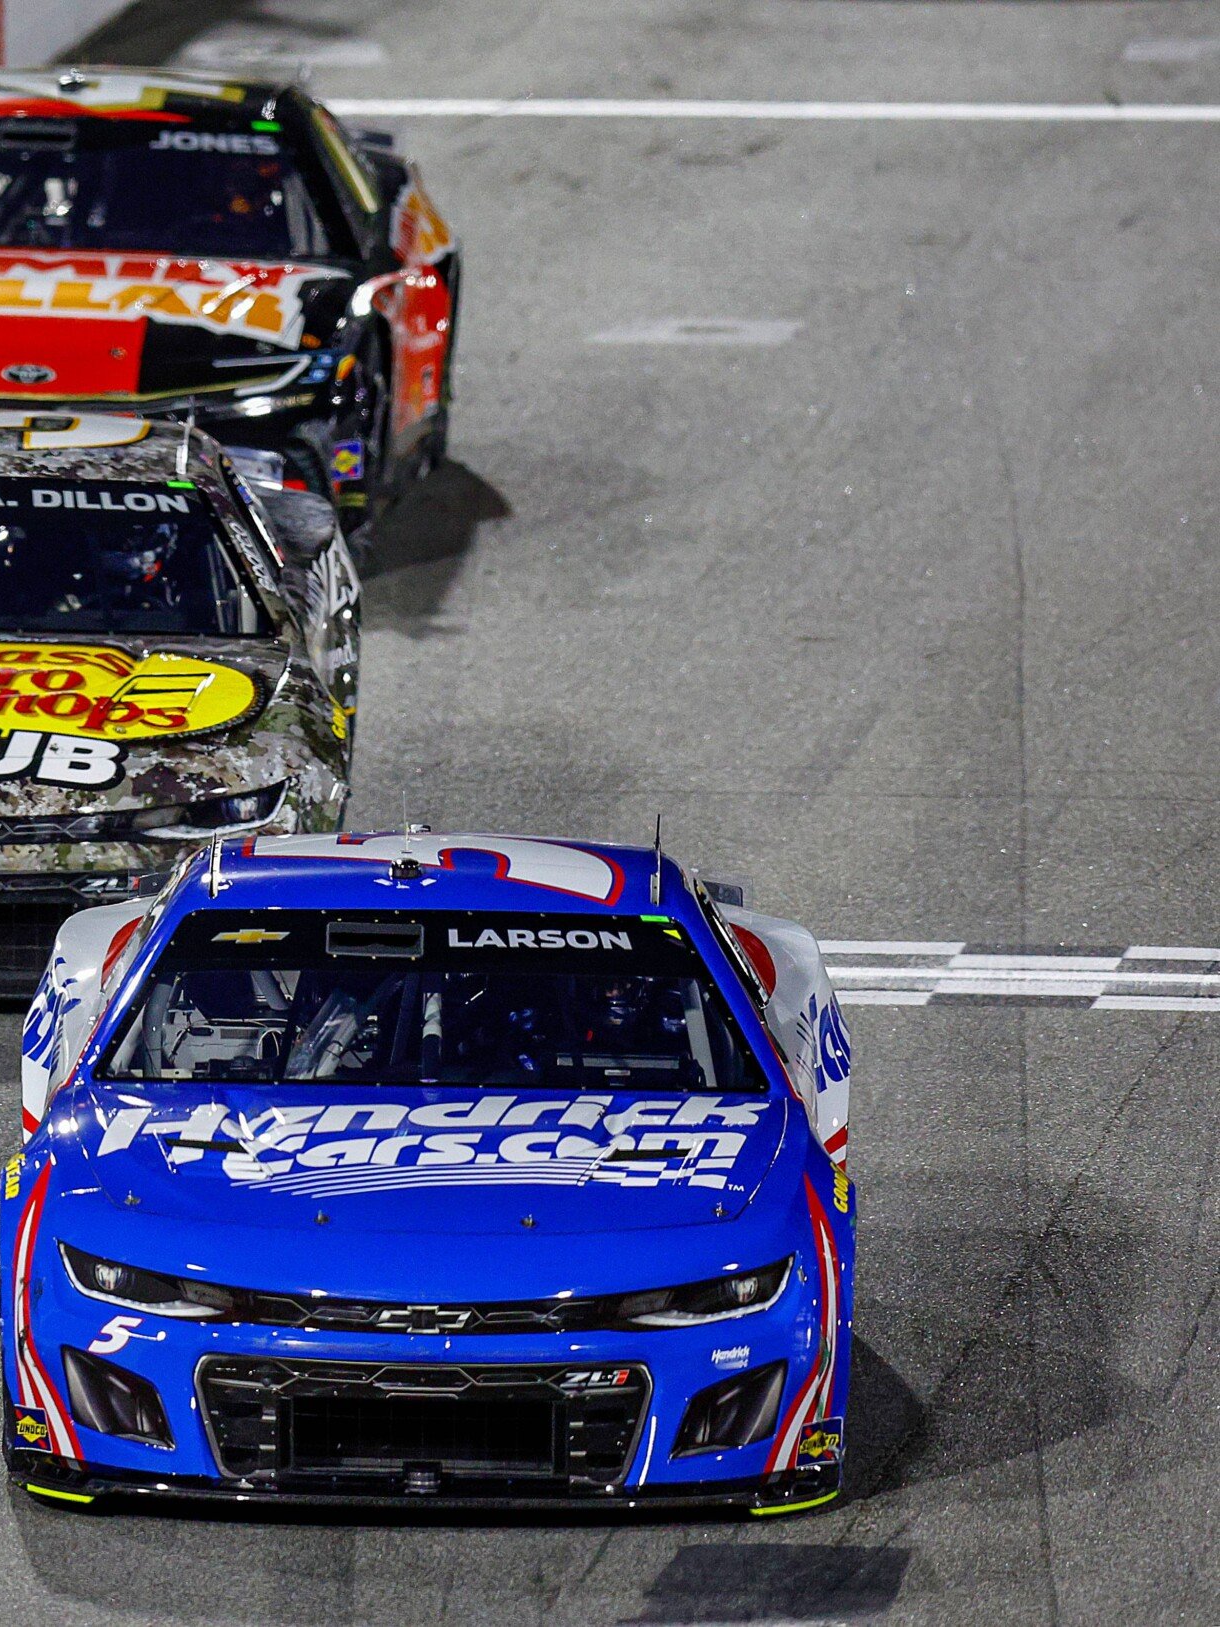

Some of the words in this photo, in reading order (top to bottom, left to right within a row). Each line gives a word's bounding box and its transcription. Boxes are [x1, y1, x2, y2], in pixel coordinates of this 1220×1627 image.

[149, 130, 280, 156] JONES
[31, 488, 191, 514] DILLON
[447, 928, 633, 950] LARSON
[96, 1095, 770, 1165] Hendrick
[88, 1315, 144, 1354] 5
